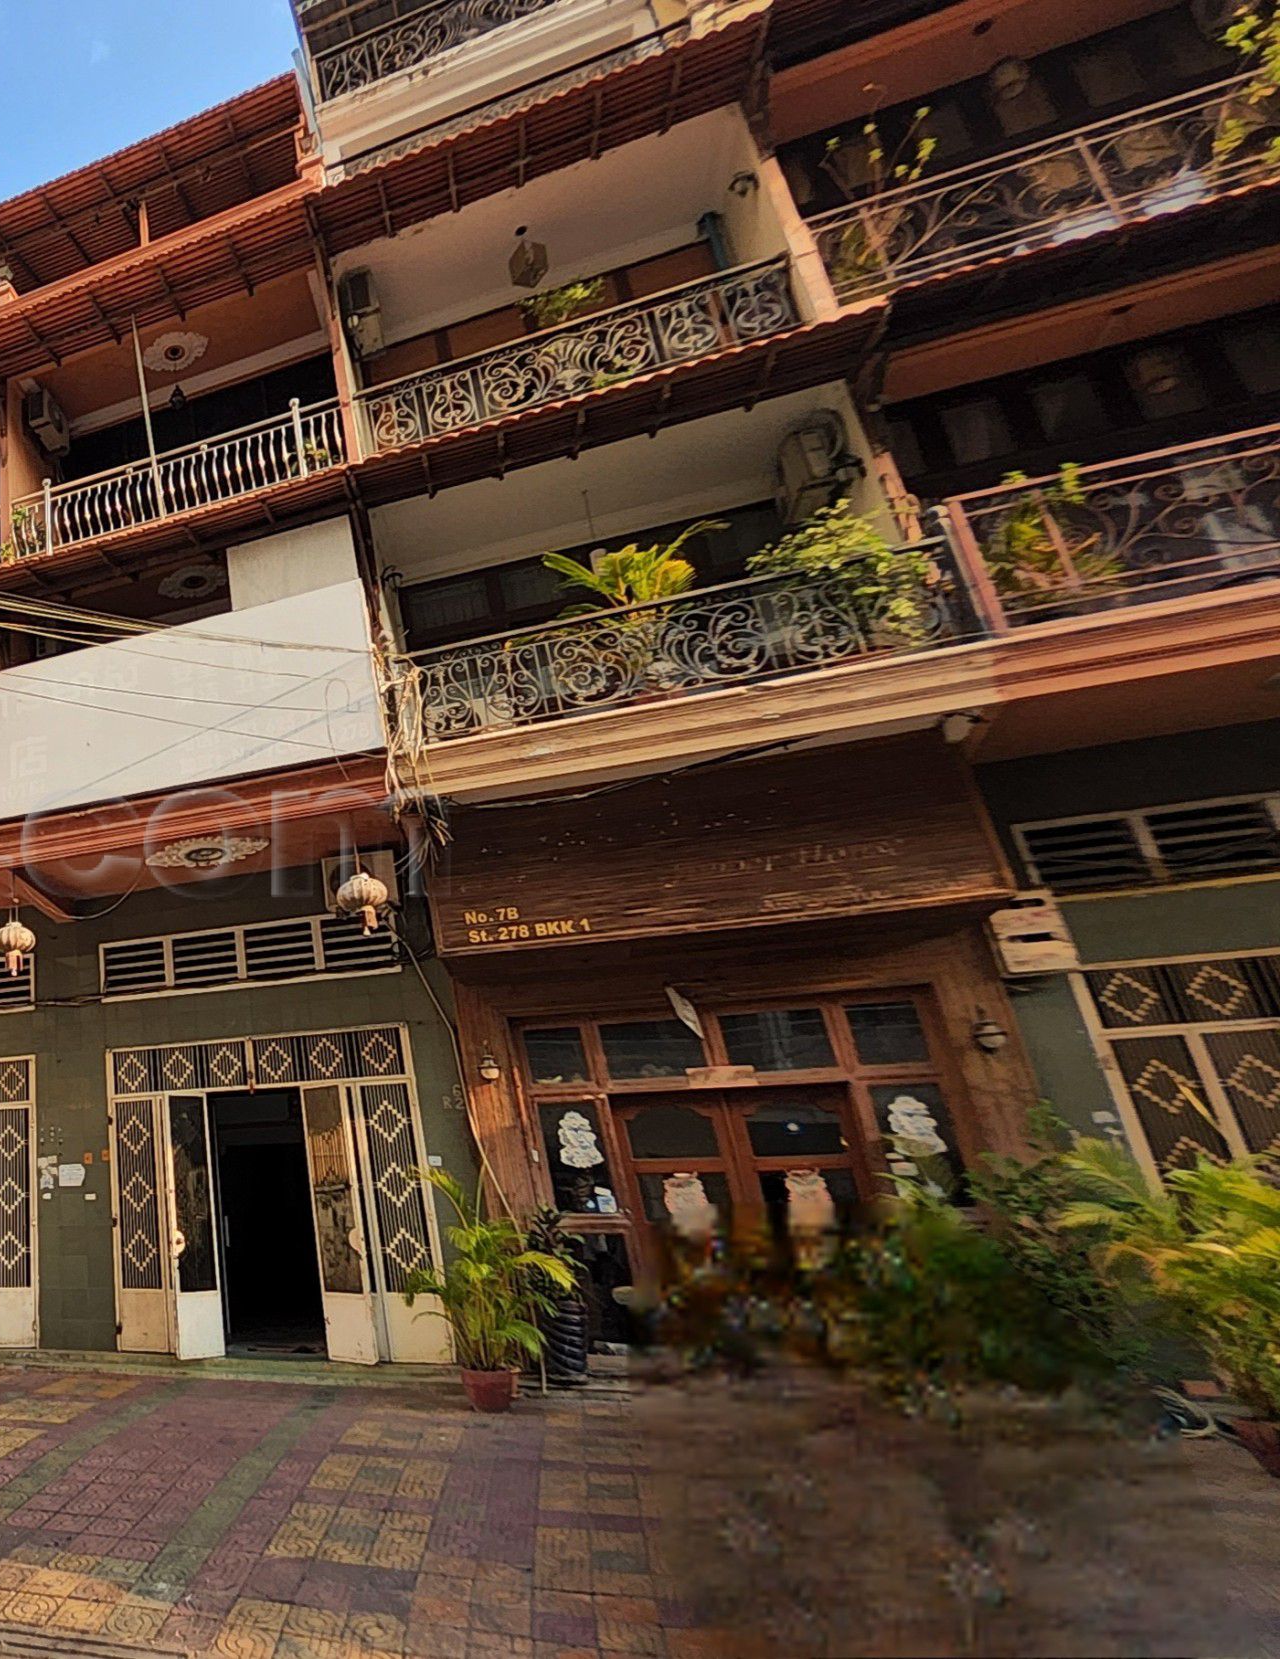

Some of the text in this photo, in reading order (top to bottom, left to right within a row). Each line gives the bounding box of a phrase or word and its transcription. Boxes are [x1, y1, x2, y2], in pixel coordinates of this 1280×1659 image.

[464, 907, 519, 925] No. 7B
[468, 918, 591, 943] St. 278 BKK 1
